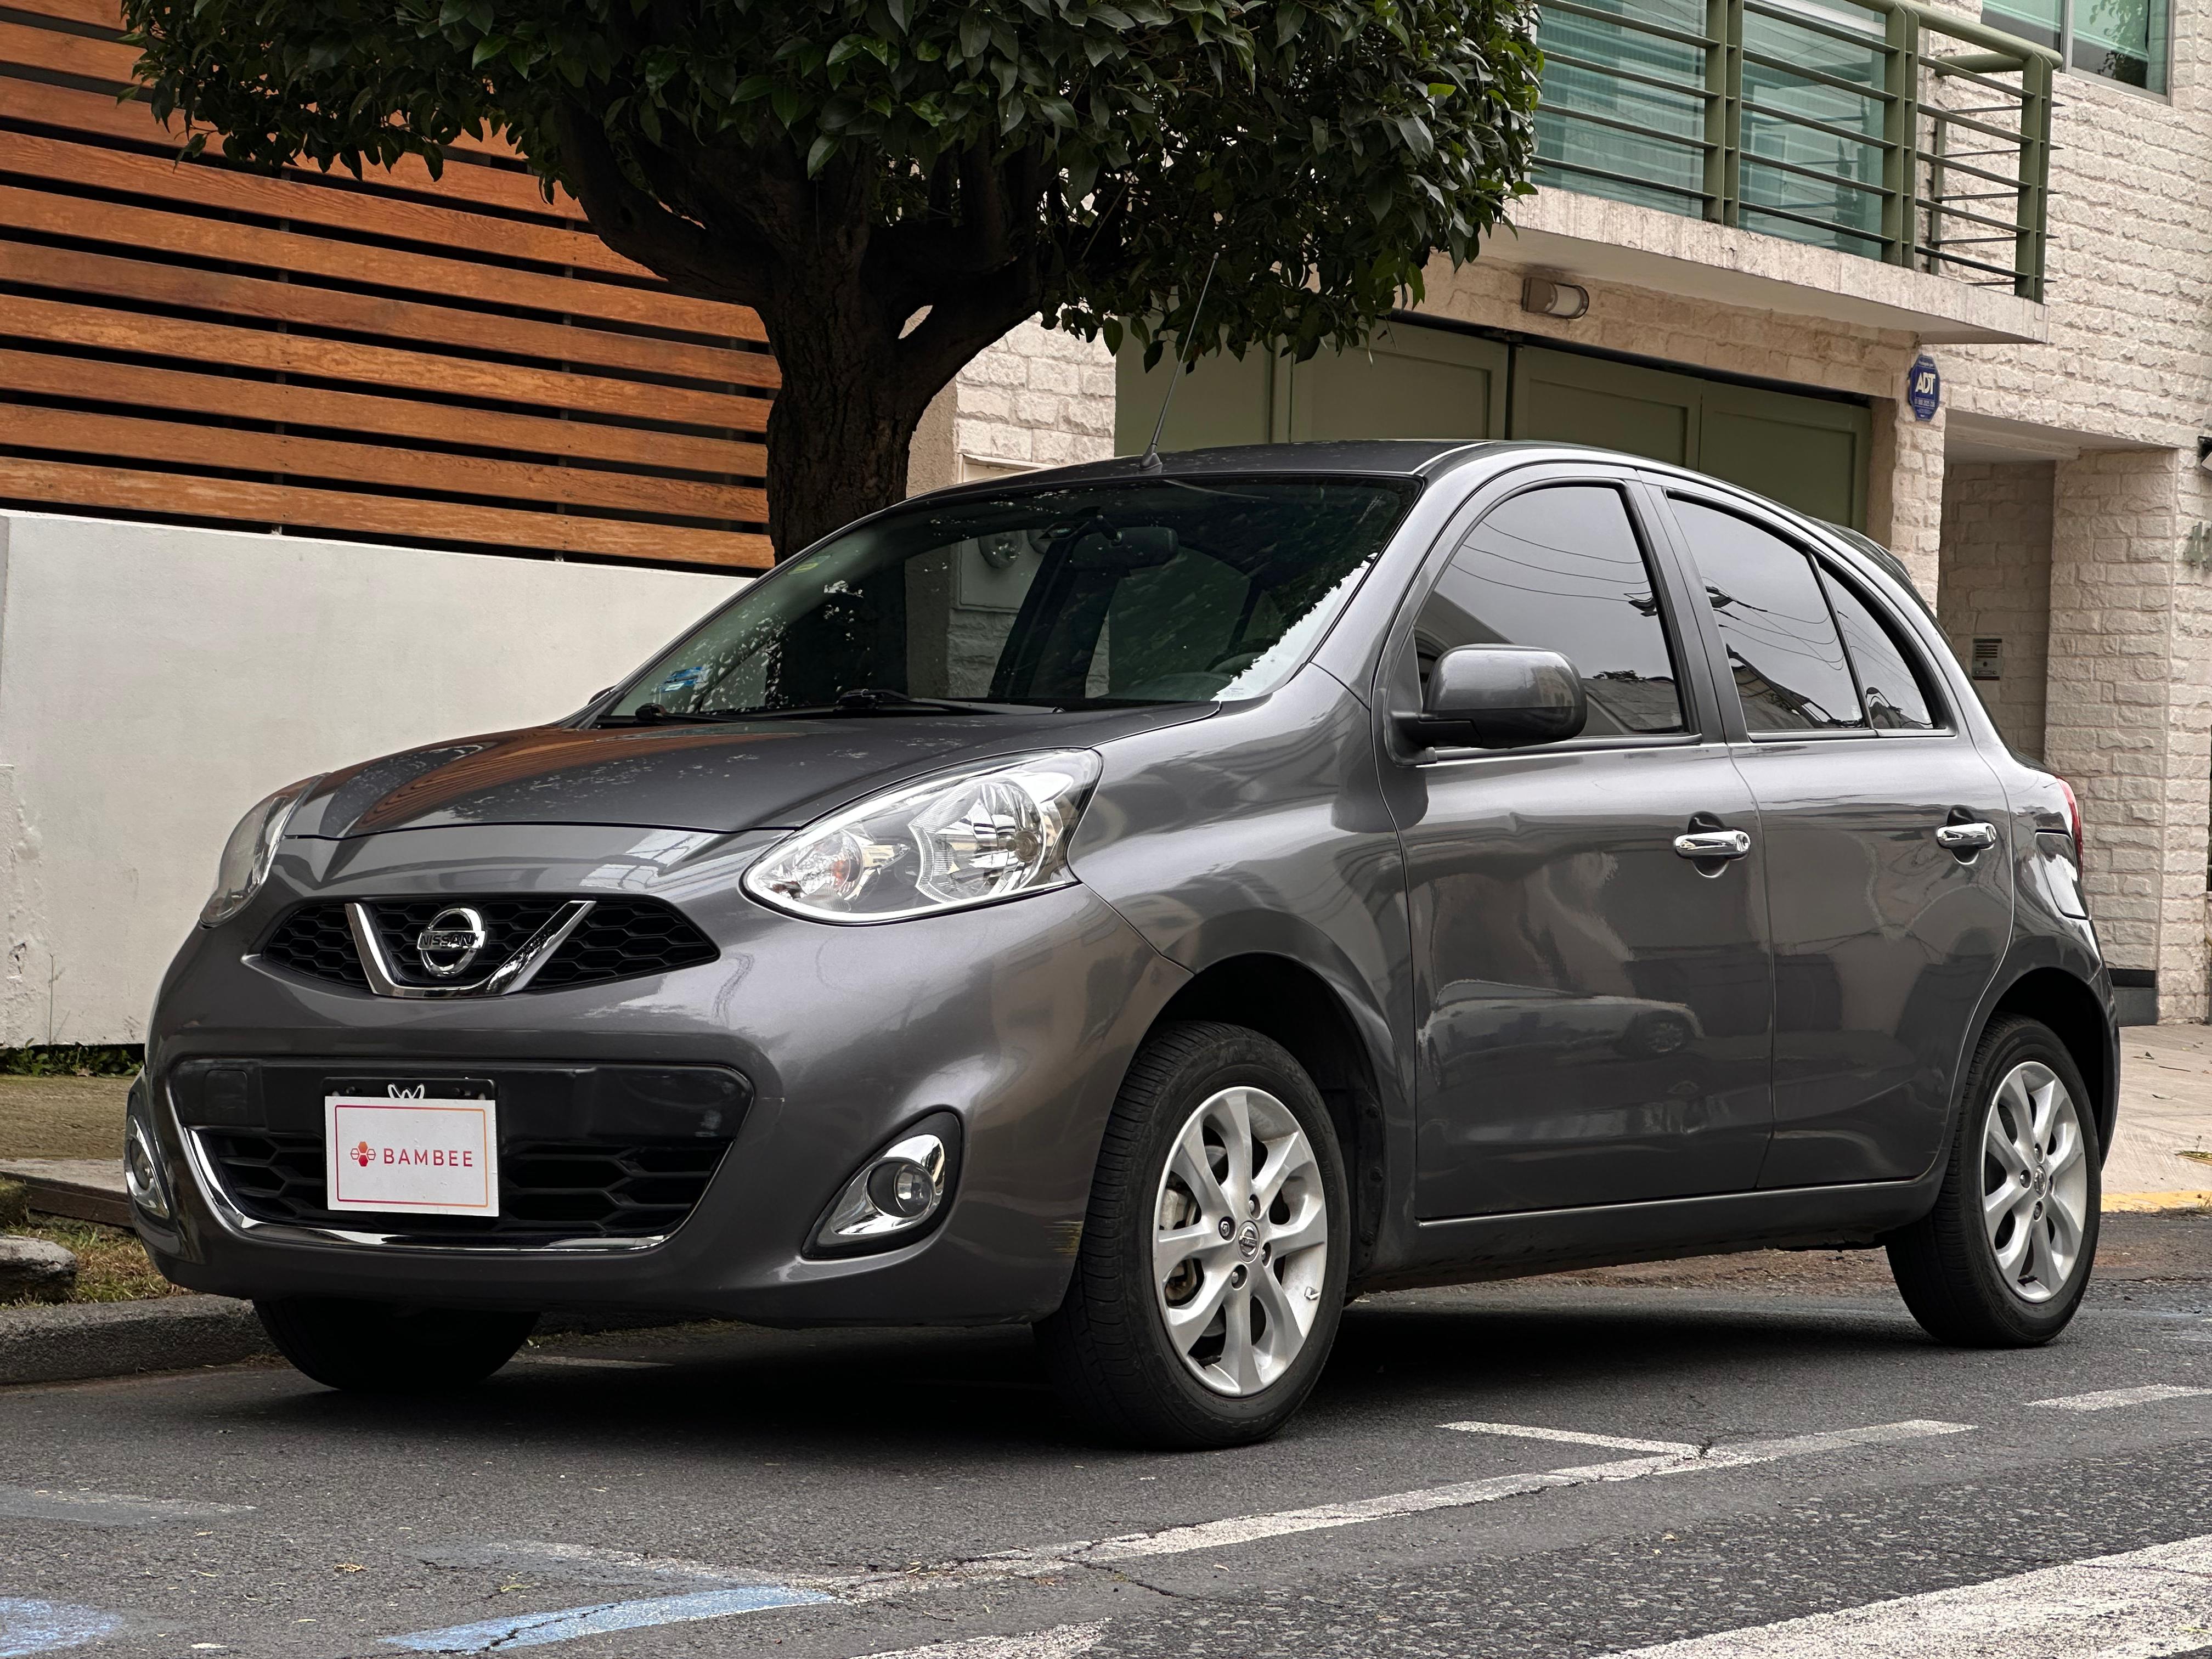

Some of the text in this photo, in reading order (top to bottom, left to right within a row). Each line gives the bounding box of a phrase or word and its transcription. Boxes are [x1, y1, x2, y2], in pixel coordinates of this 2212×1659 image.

[1915, 373, 1936, 394] ADT
[420, 934, 472, 946] NISSAN
[383, 1148, 473, 1167] BAMBEE
